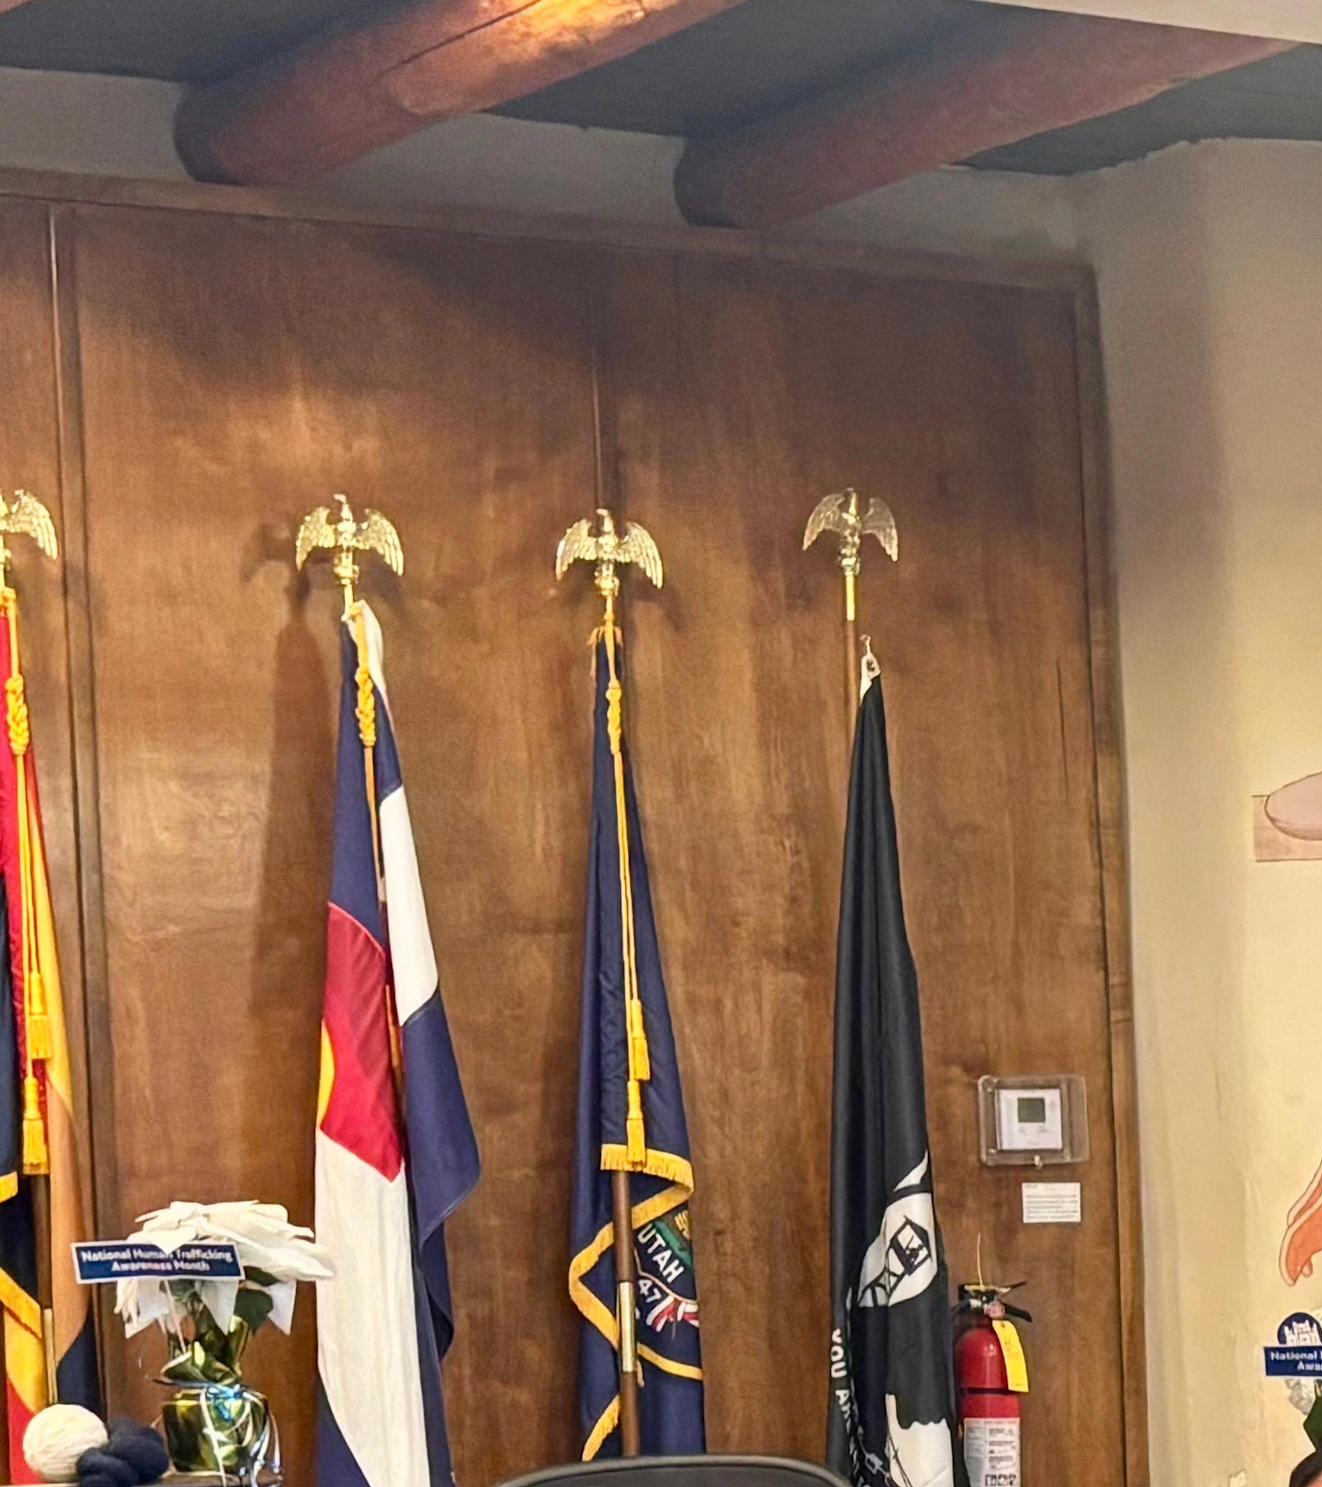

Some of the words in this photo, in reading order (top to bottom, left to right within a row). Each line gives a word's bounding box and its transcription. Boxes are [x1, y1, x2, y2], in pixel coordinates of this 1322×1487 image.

[81, 1248, 132, 1262] National
[175, 1247, 233, 1264] Trafficking
[637, 1222, 685, 1284] UTAH
[174, 1259, 210, 1272] Month
[1270, 1350, 1318, 1361] National
